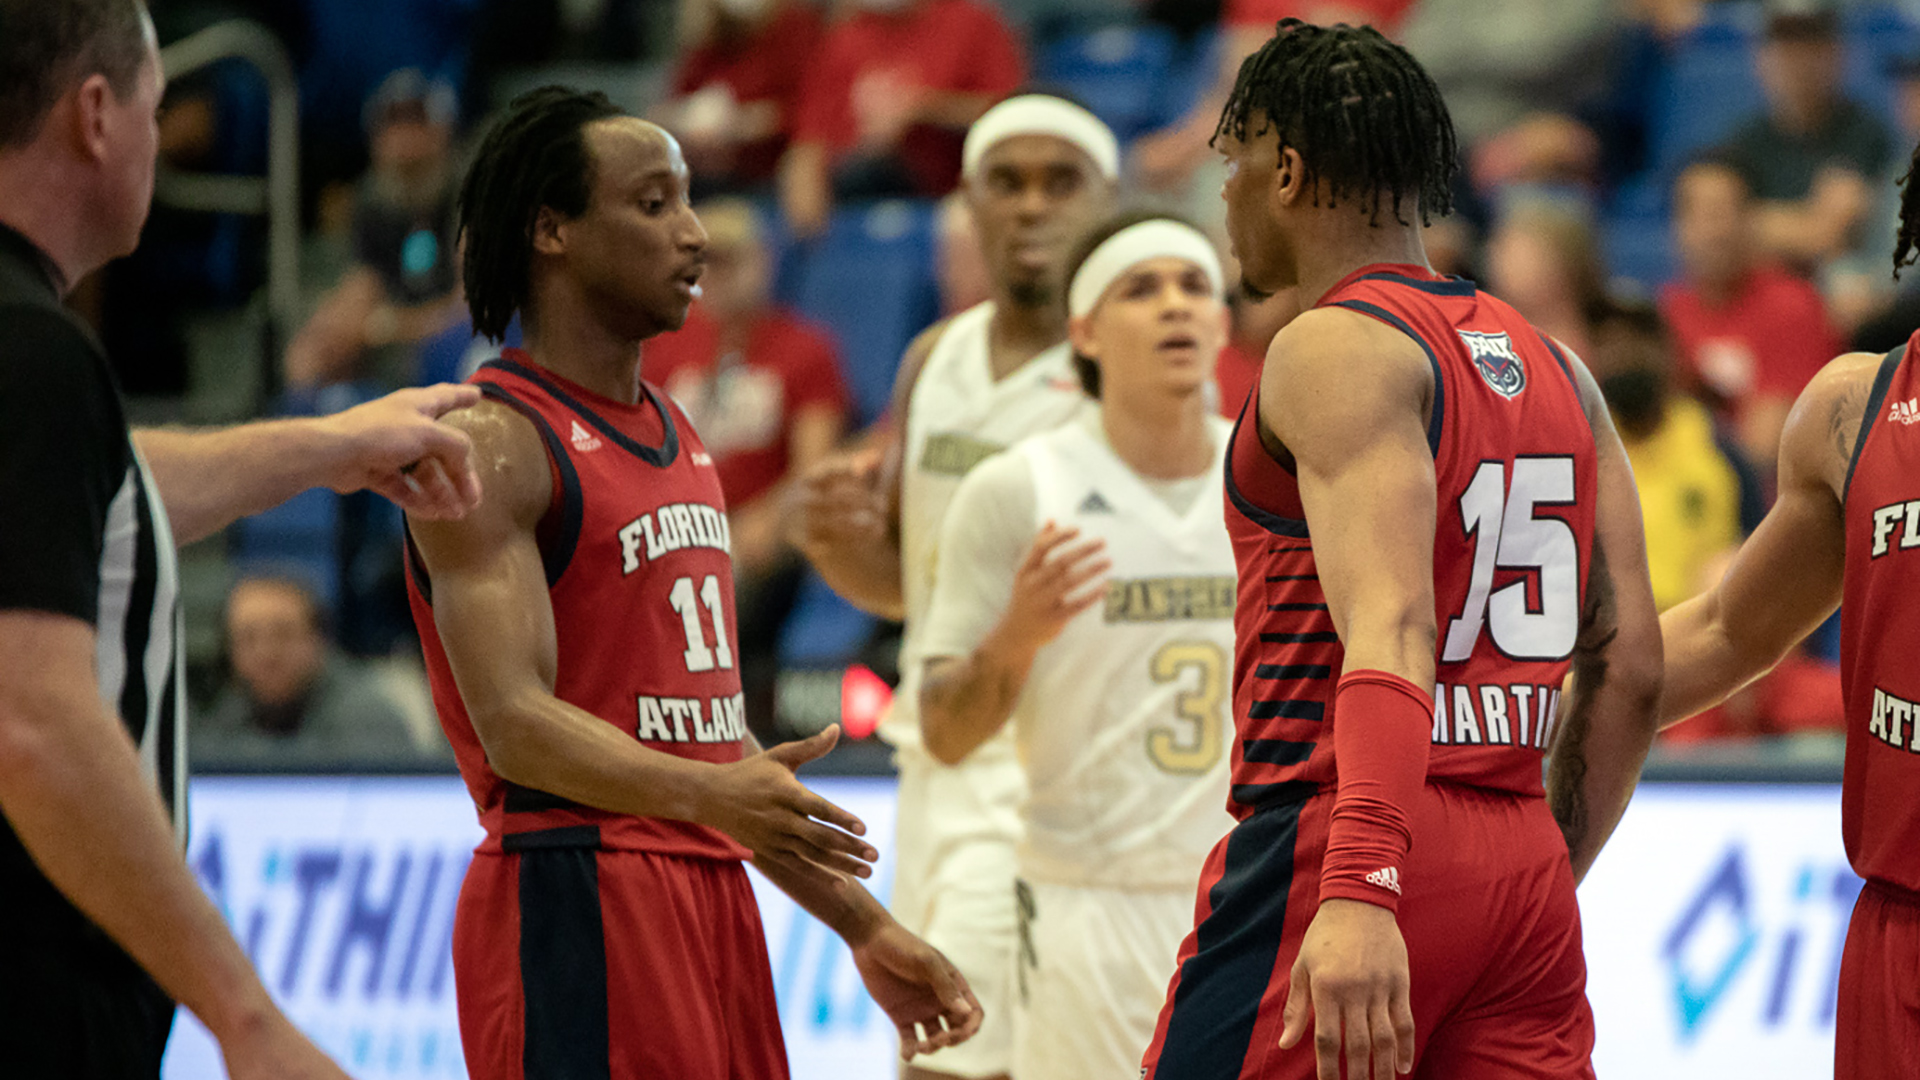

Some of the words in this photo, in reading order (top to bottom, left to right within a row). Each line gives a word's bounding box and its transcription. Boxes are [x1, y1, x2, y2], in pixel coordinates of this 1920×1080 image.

[1440, 453, 1577, 662] 15
[669, 575, 734, 672] 11
[1147, 637, 1230, 778] 3
[1365, 873, 1402, 897] adida
